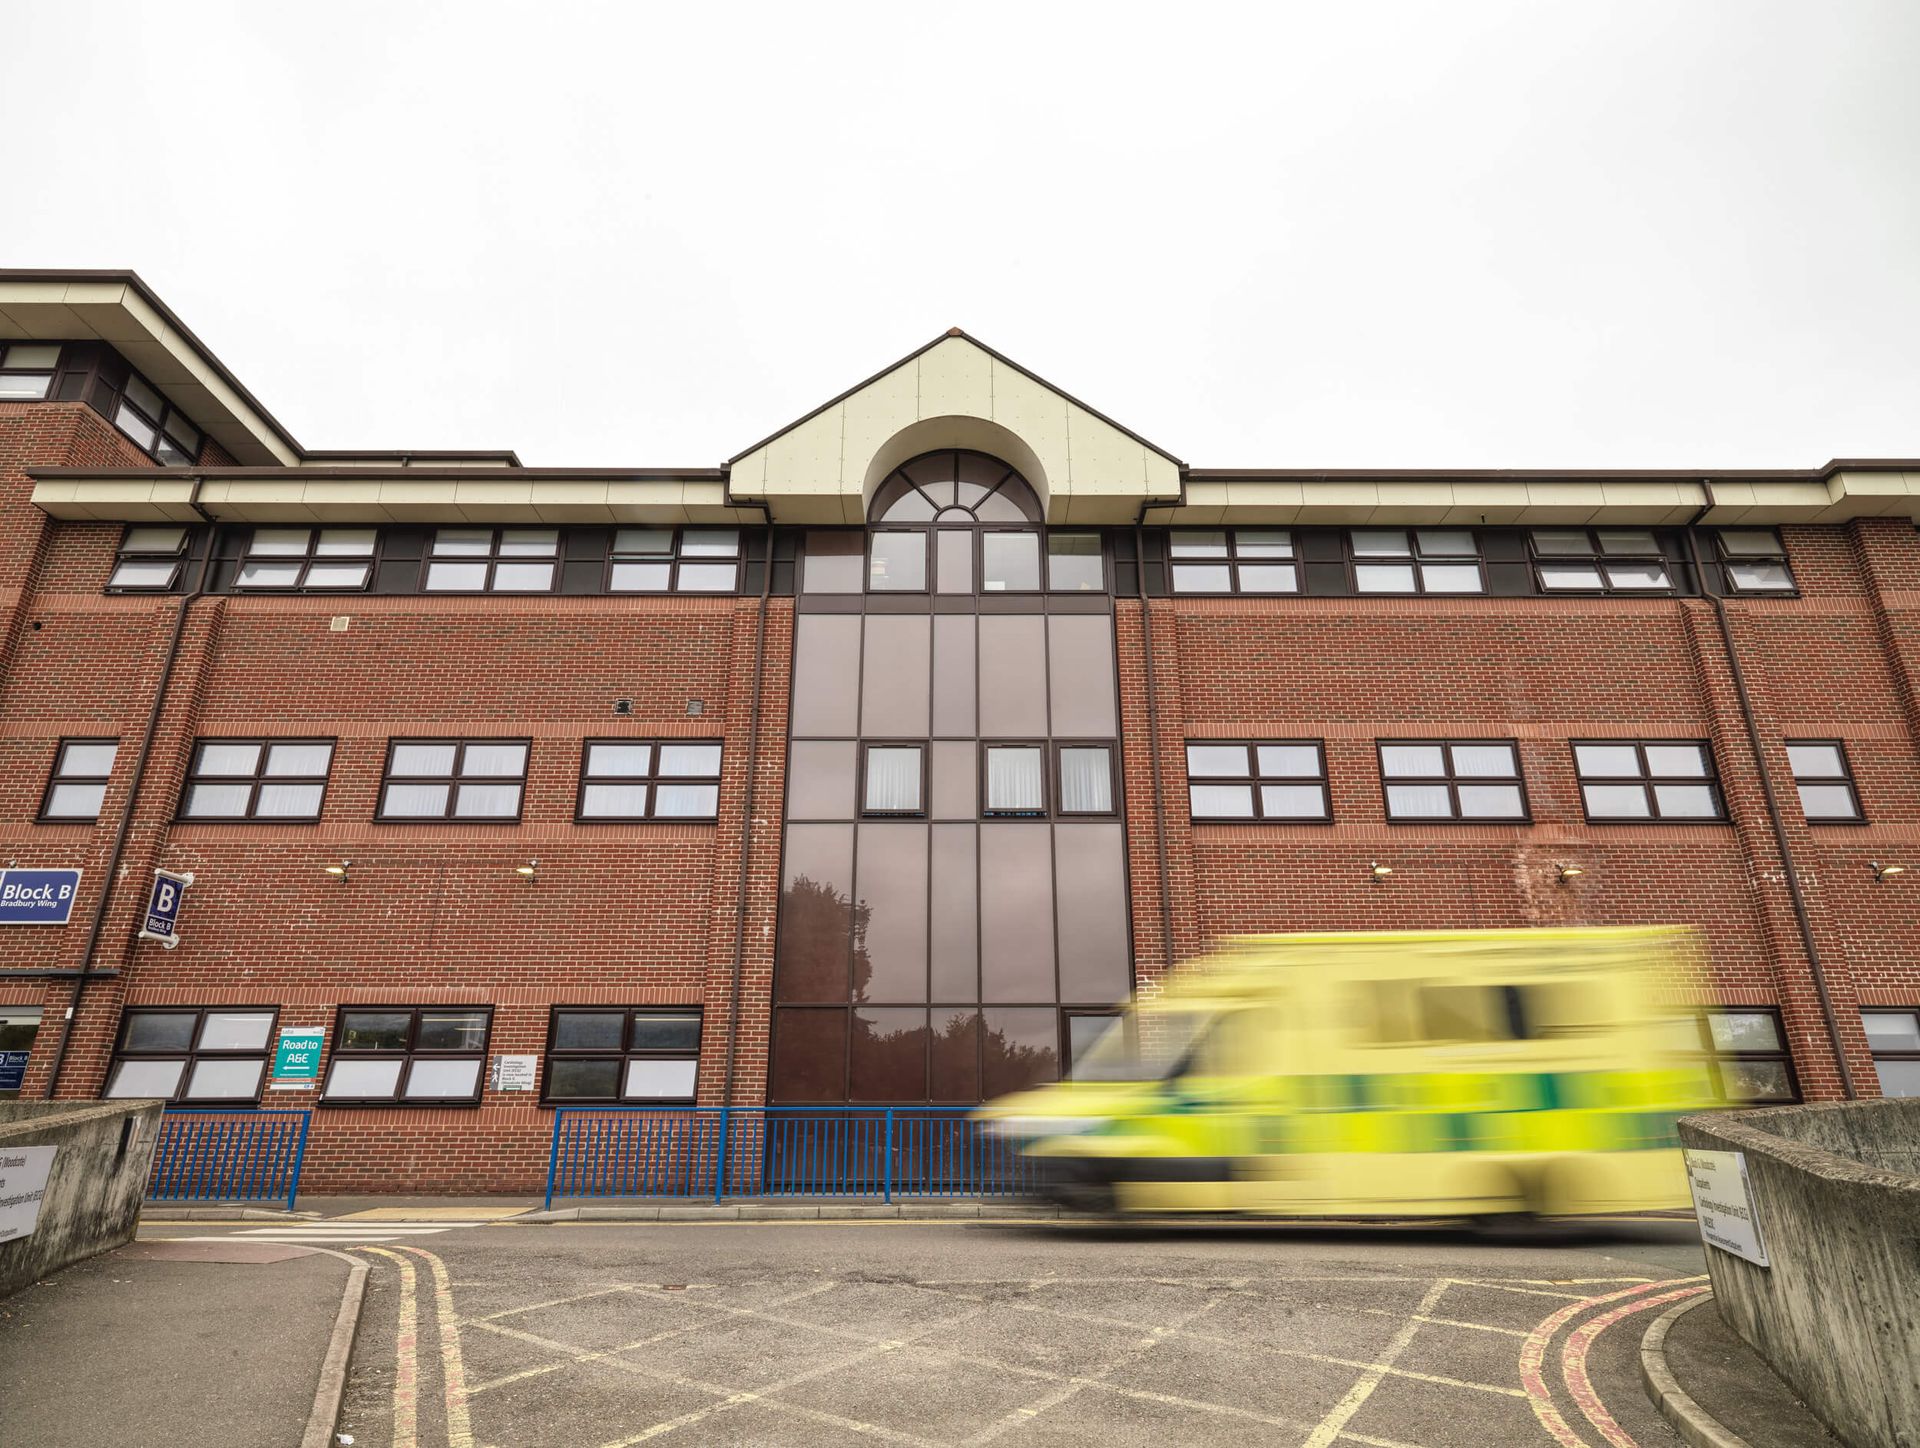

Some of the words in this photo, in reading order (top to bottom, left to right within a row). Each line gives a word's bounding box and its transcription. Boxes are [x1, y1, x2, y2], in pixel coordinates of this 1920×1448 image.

[3, 883, 53, 900] Block
[58, 884, 72, 900] B
[0, 899, 37, 908] Bradbury
[37, 900, 58, 908] Wing
[156, 883, 175, 913] B
[148, 918, 166, 929] Block
[165, 922, 172, 930] B
[282, 1039, 308, 1050] Road
[308, 1040, 319, 1050] to
[286, 1053, 310, 1064] A&E
